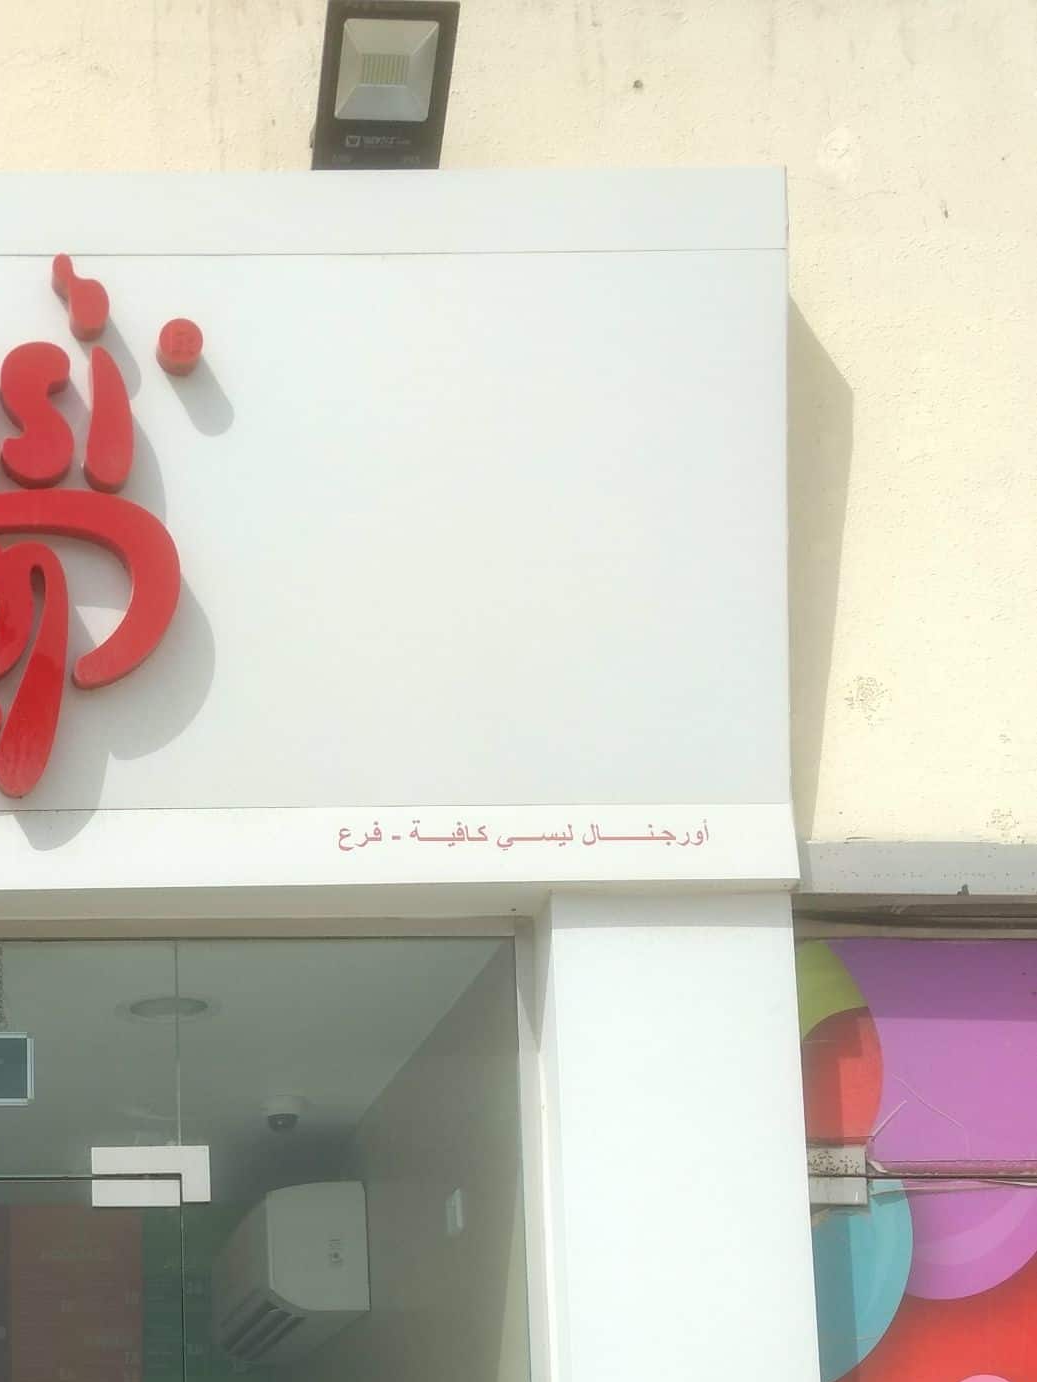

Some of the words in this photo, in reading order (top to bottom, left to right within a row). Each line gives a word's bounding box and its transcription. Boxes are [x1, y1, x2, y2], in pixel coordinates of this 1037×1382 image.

[337, 820, 383, 852] فرع
[409, 819, 489, 848] كافية
[496, 823, 574, 853] ليسي
